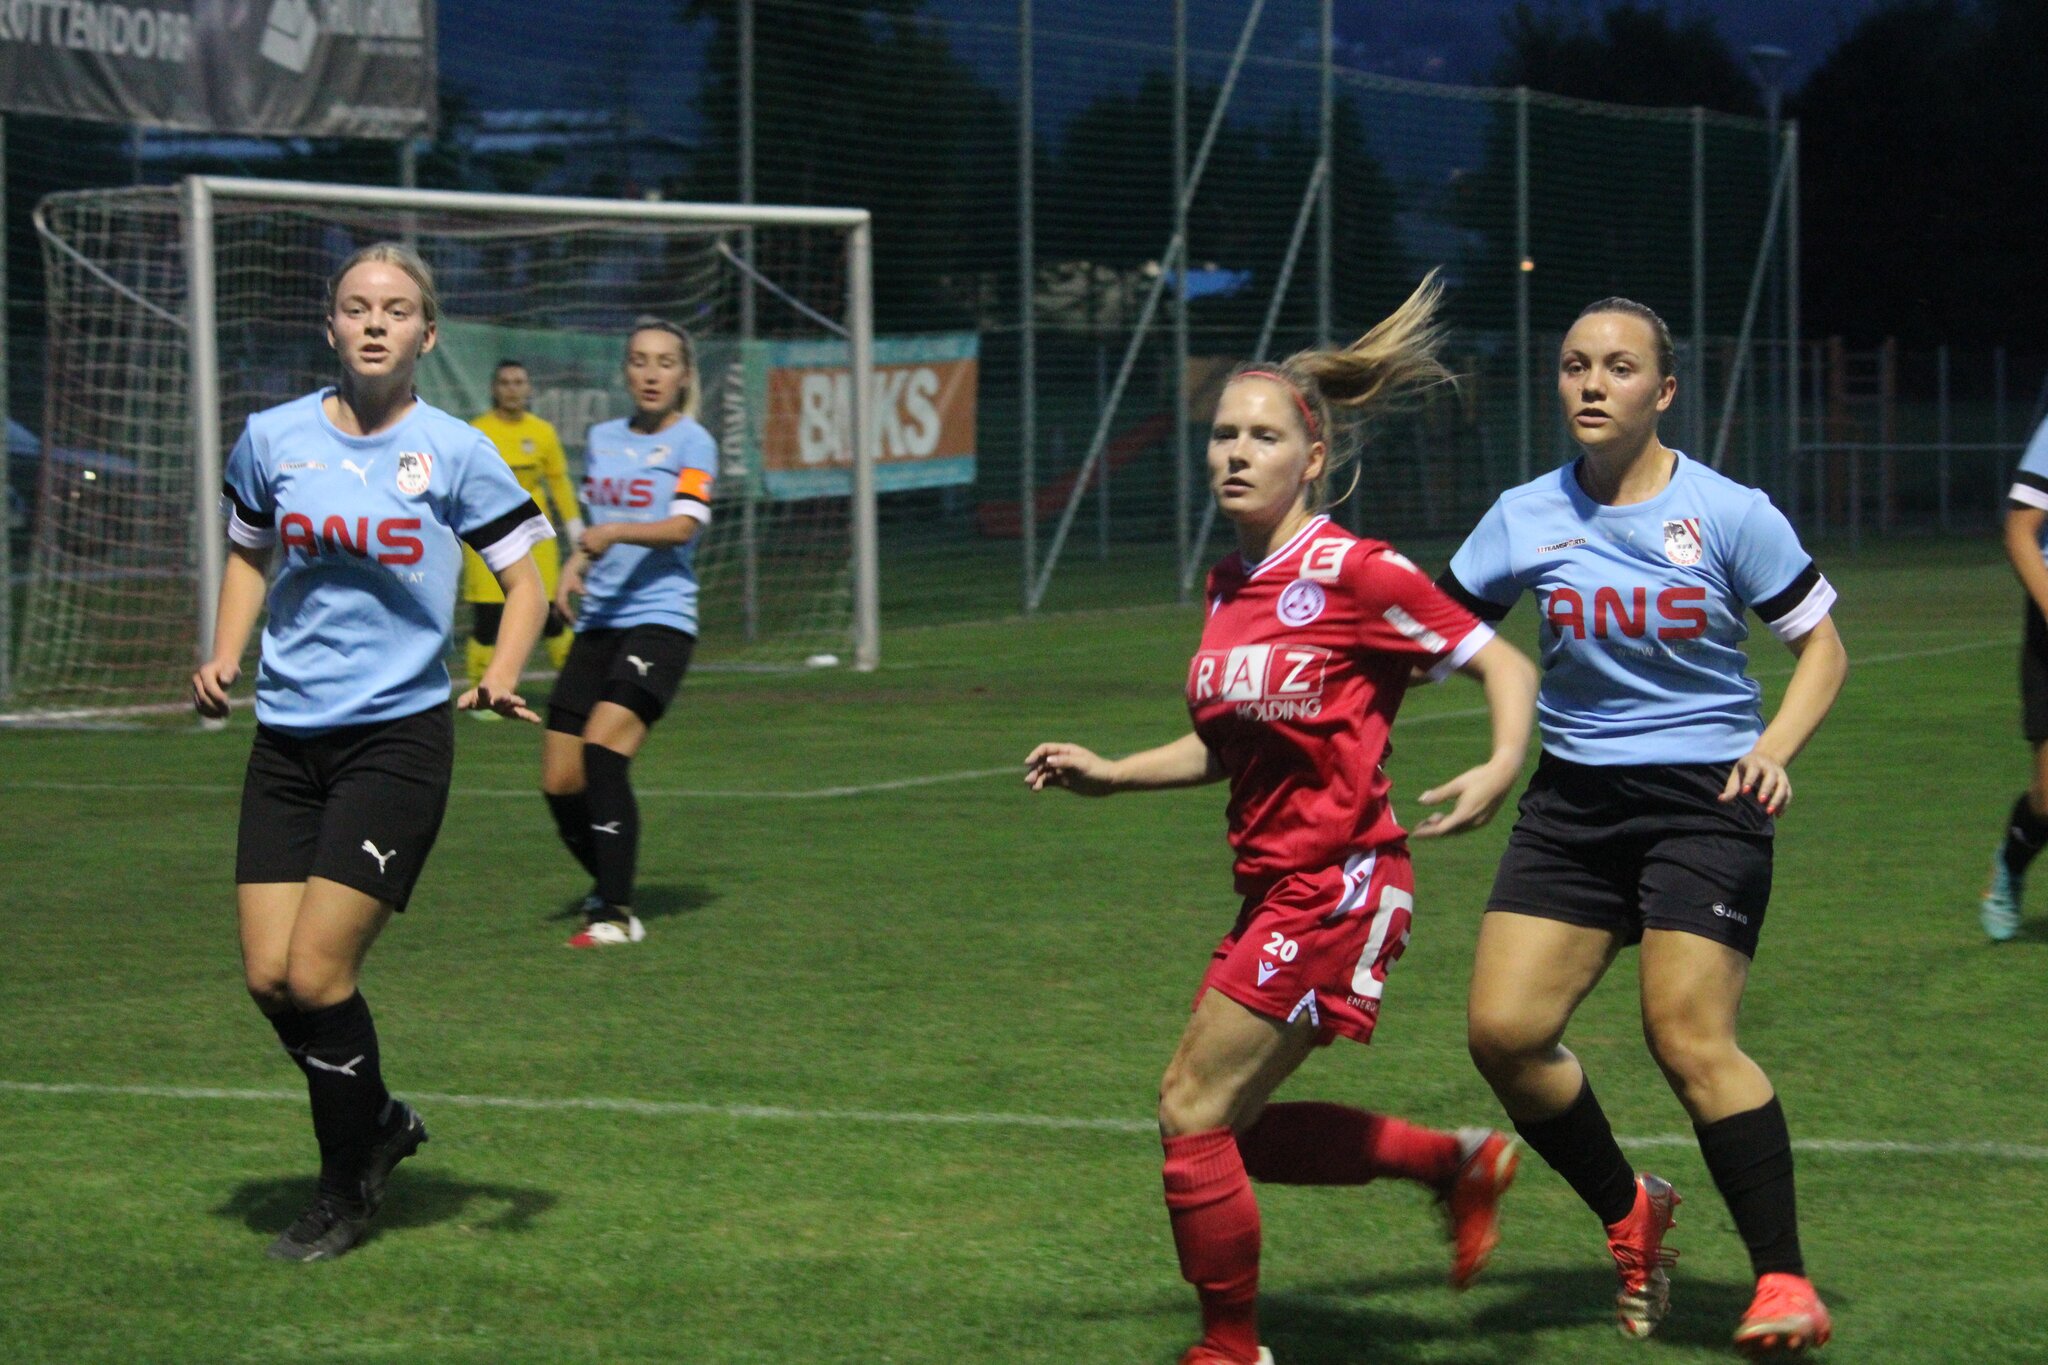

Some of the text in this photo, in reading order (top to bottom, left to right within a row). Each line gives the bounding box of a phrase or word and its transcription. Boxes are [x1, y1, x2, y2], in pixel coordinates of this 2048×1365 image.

[280, 513, 424, 566] ANS
[1547, 586, 1708, 640] ANS
[1236, 699, 1322, 722] HOLDING
[1726, 909, 1748, 925] JAKO
[1263, 932, 1299, 962] 20
